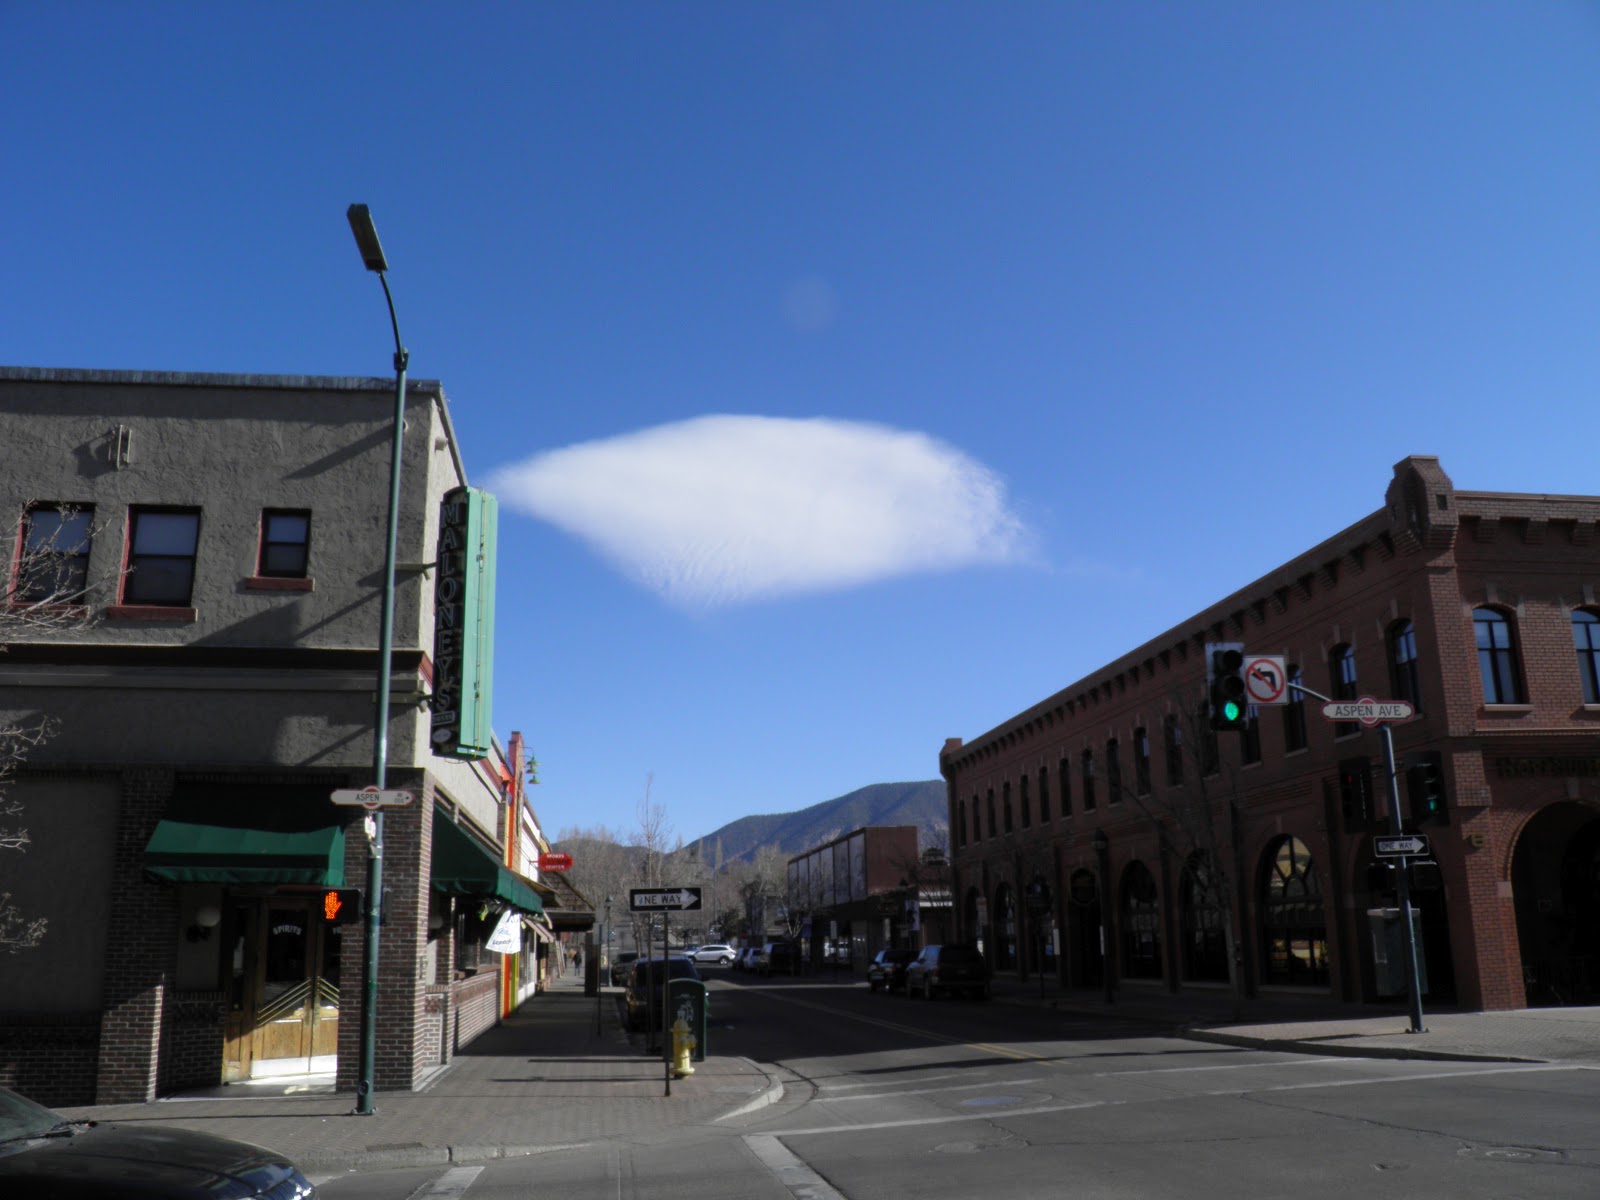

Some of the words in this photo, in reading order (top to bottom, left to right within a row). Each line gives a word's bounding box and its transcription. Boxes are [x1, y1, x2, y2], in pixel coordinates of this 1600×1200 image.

[1335, 705, 1373, 717] ASPEN
[1378, 704, 1402, 717] AVE
[355, 793, 380, 802] ASPEN
[1381, 842, 1395, 850] ONE
[1399, 842, 1413, 850] WAY
[661, 894, 681, 904] WAY
[272, 924, 303, 936] SPIRITS
[332, 926, 342, 936] FO
